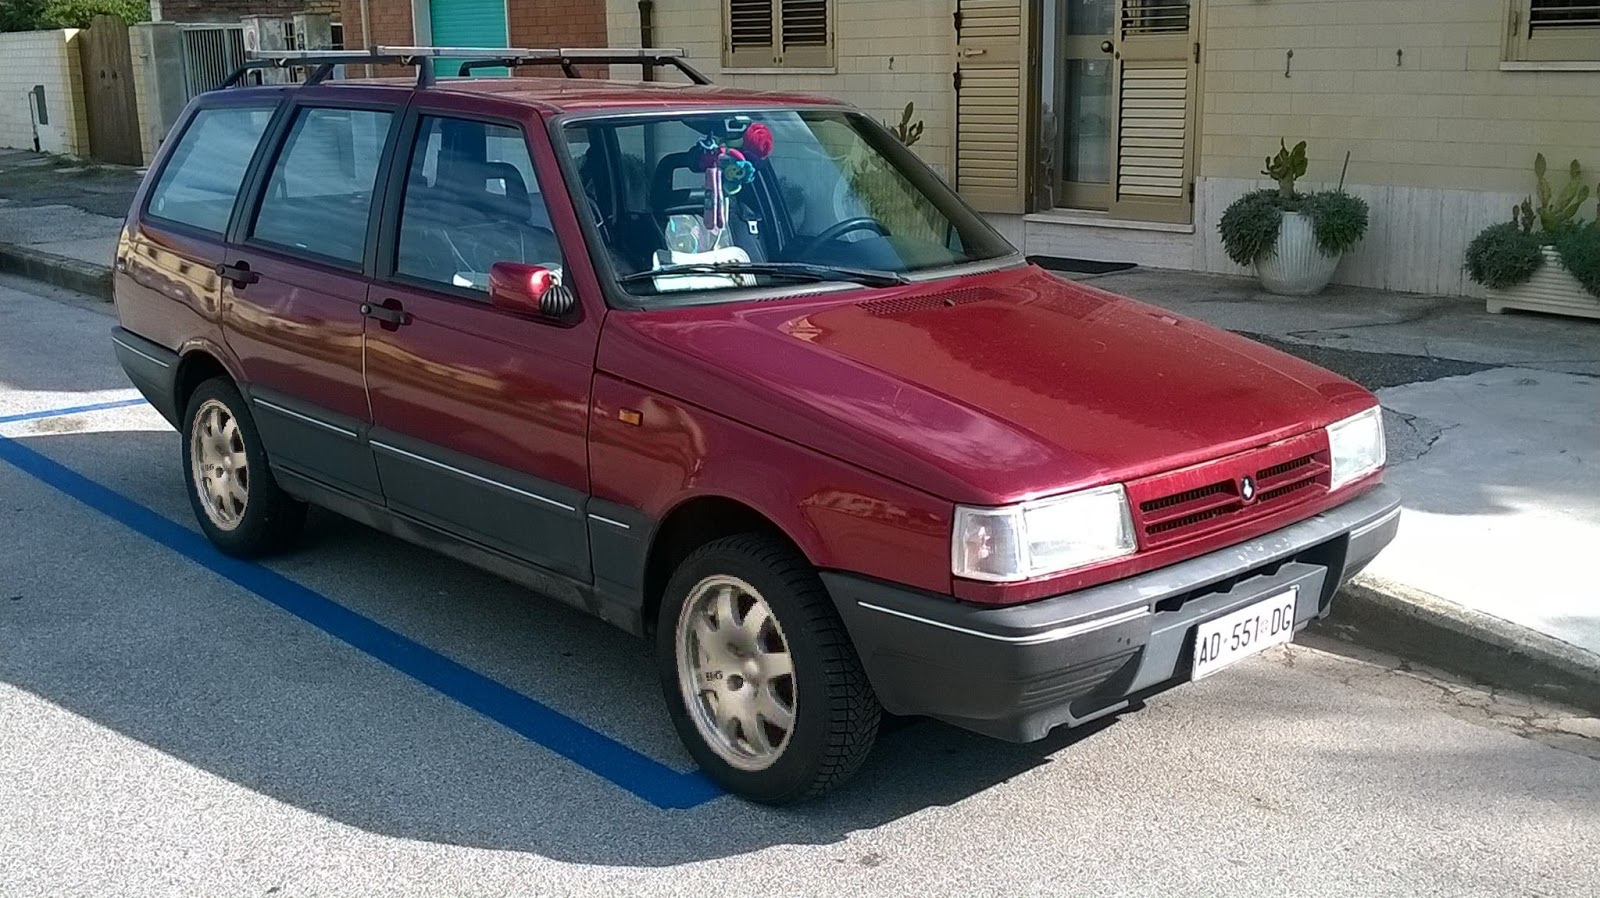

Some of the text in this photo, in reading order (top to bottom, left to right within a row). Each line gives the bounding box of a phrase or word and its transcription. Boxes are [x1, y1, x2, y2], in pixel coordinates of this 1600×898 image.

[1198, 603, 1292, 667] AD 551 DG
